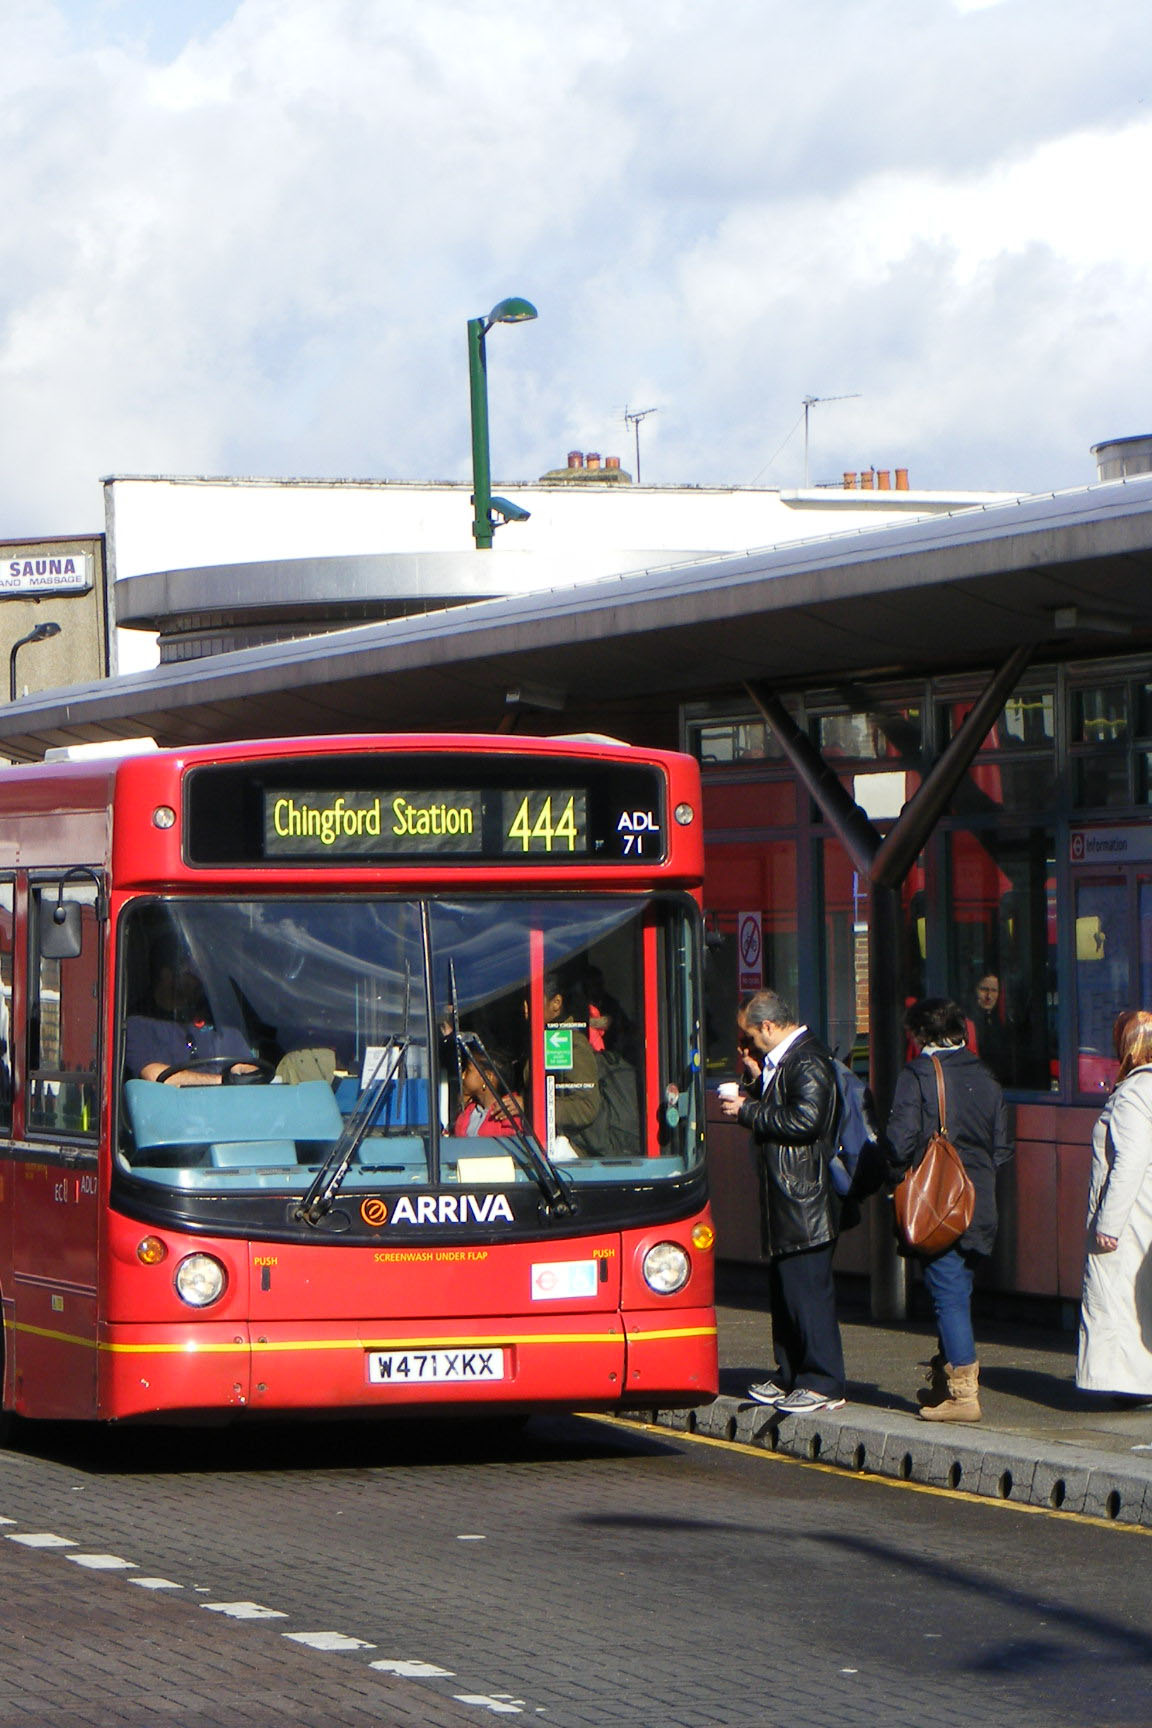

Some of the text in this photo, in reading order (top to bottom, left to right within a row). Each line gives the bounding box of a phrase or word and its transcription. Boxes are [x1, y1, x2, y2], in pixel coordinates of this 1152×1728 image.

[10, 558, 75, 577] SAUNA
[29, 575, 82, 586] MASSAGE
[274, 796, 577, 852] Chingford Station 444
[617, 812, 659, 831] ADL
[623, 835, 642, 854] 71
[1086, 836, 1128, 853] Information
[391, 1194, 515, 1224] ARRIVA
[254, 1257, 278, 1266] PUSH
[374, 1251, 488, 1262] SCREENWASH UNDER FLAP
[593, 1249, 615, 1258] PUSH
